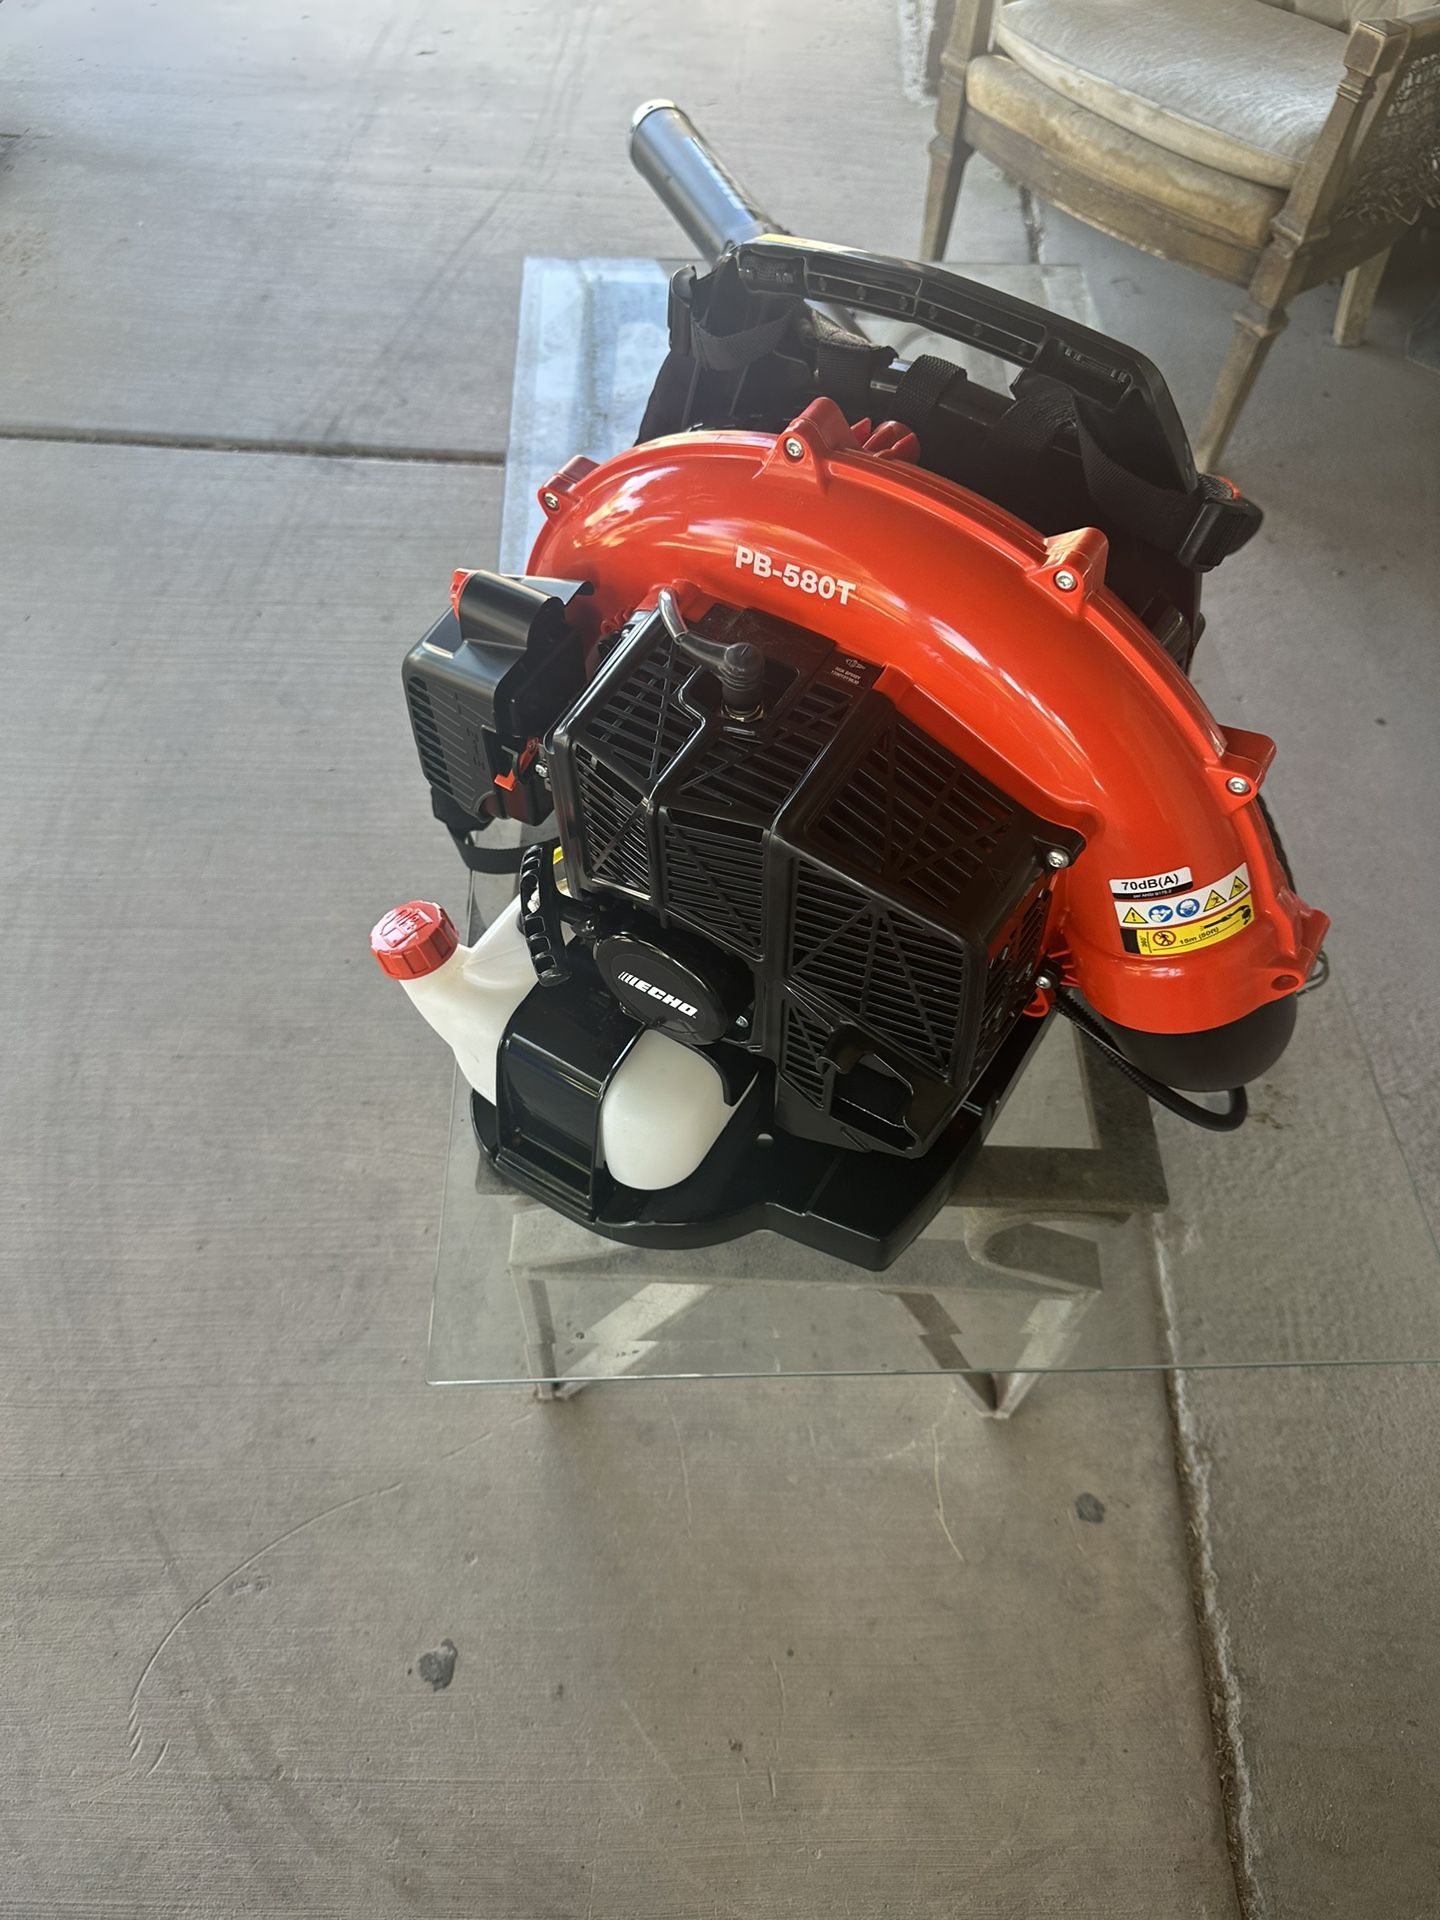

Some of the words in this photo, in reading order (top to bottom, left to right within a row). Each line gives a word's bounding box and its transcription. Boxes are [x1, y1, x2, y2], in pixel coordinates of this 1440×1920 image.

[735, 545, 857, 605] PB-580T
[1121, 874, 1179, 890] 70dB(A)
[1180, 936, 1197, 945] 15m
[634, 979, 698, 1016] ECHO
